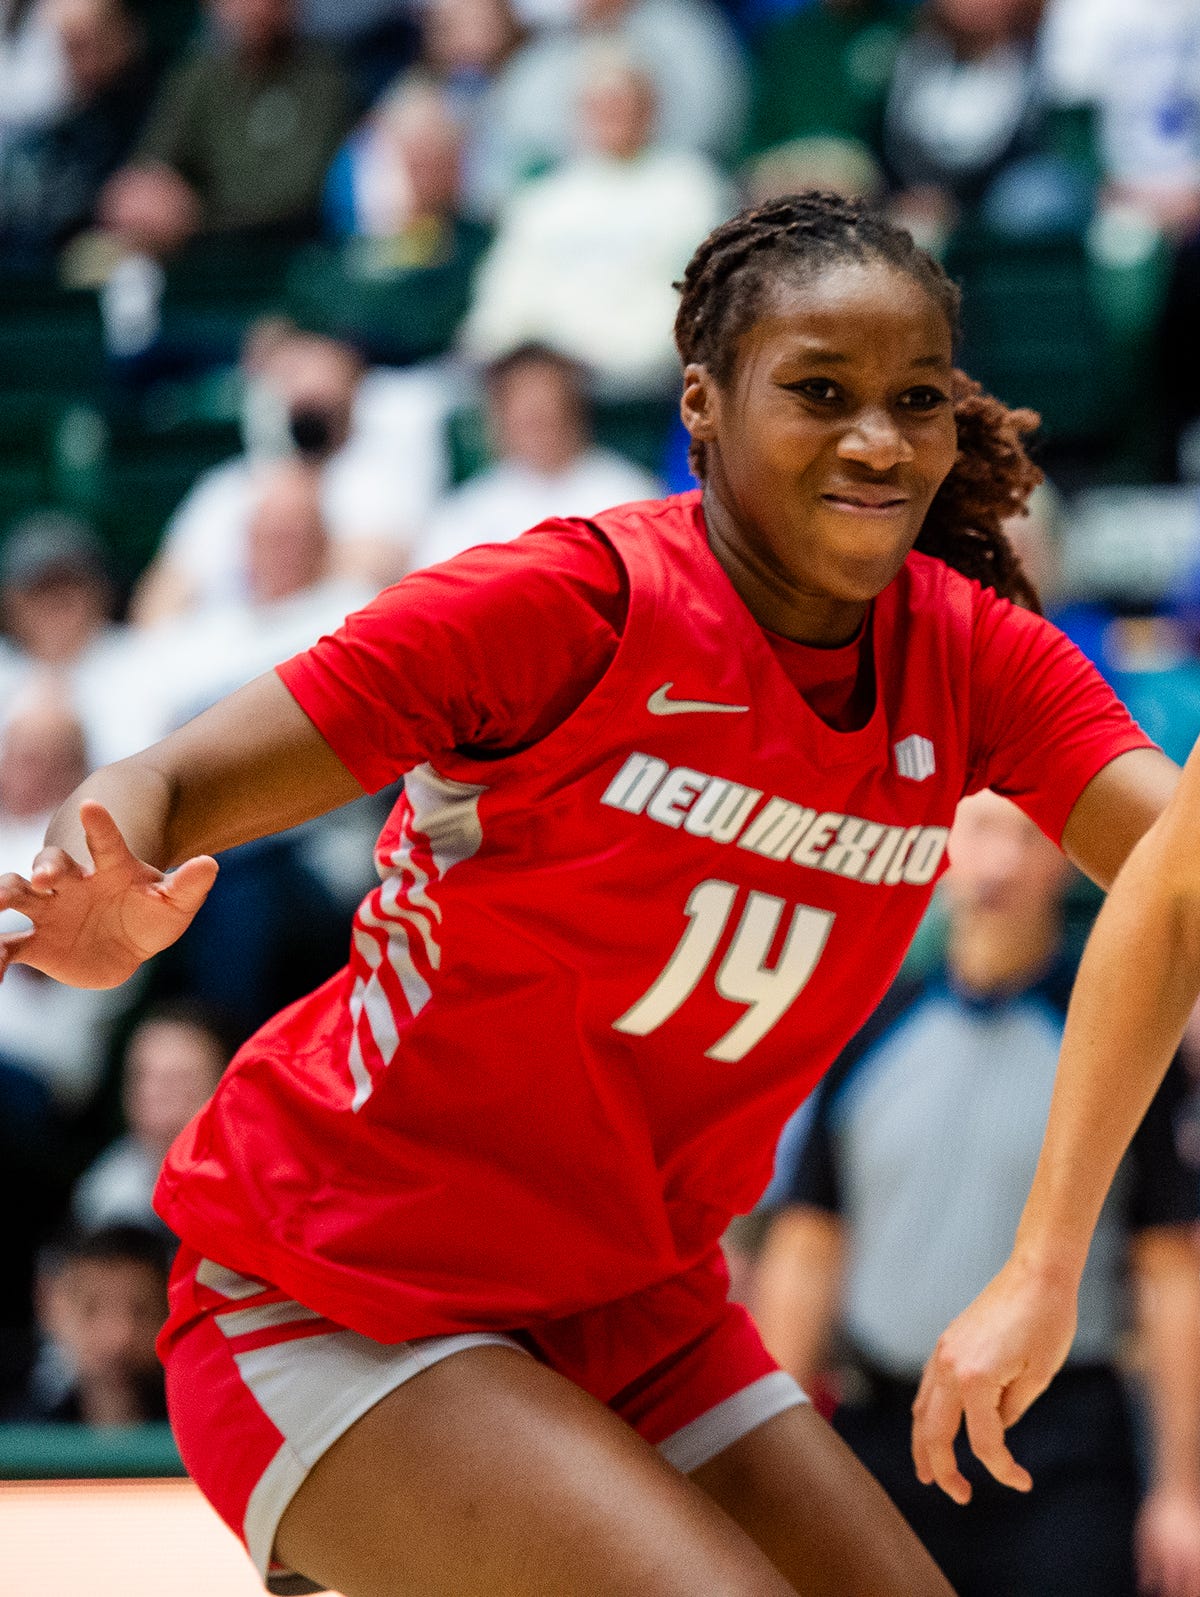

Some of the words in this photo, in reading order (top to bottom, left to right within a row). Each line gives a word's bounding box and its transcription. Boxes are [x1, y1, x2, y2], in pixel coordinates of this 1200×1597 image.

[600, 751, 763, 844] NEW
[737, 795, 950, 886] MEXICO
[611, 878, 837, 1063] 14
